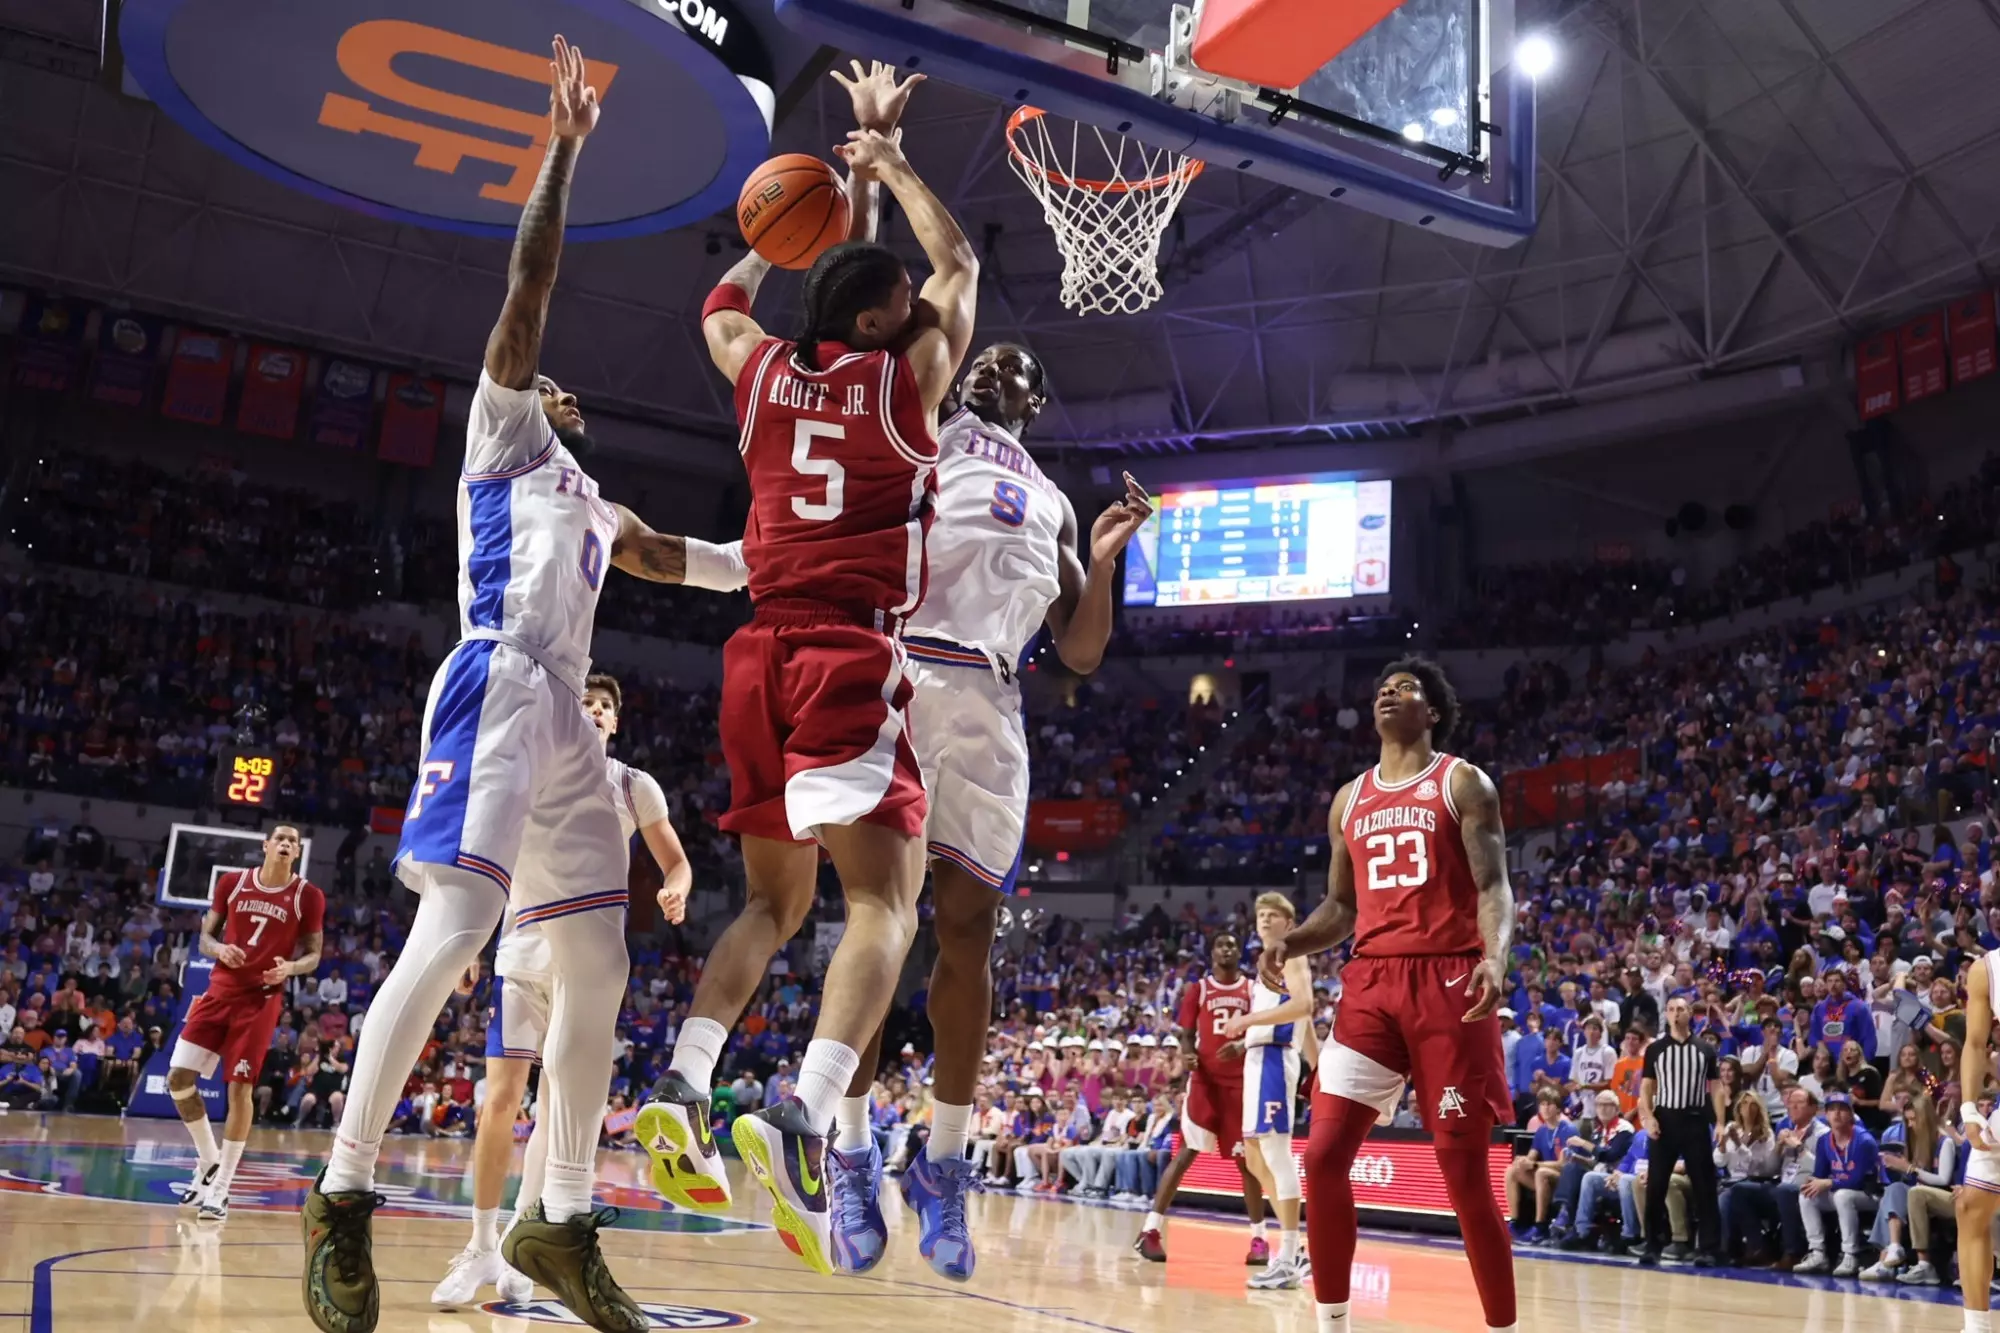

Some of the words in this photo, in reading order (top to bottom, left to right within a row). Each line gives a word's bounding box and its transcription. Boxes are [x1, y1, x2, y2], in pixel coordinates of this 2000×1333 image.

[741, 181, 784, 229] ELITE
[768, 374, 830, 412] ACUFF
[841, 384, 870, 416] JR.
[791, 418, 846, 522] 5
[989, 480, 1028, 528] 9
[579, 529, 604, 592] 0
[228, 772, 265, 802] 22
[406, 760, 454, 820] F
[1353, 806, 1436, 841] RAZORBACKS
[1366, 830, 1428, 890] 23
[235, 899, 288, 924] RAZORBACKS
[247, 915, 268, 947] 7
[1263, 1101, 1282, 1124] F
